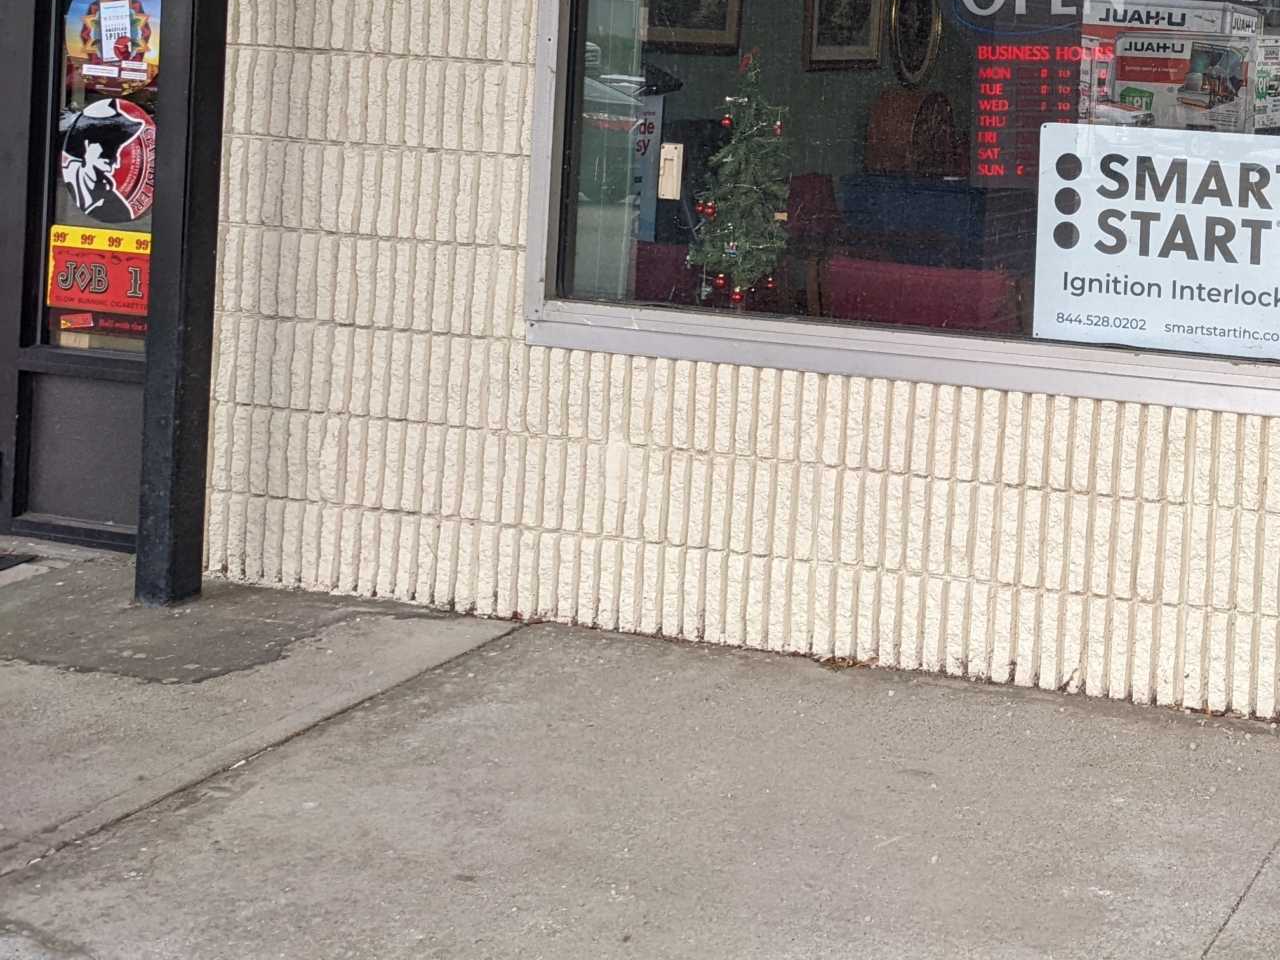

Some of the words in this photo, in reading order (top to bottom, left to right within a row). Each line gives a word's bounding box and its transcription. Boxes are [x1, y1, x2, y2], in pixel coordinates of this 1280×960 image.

[977, 45, 1049, 61] BUSINESS
[1055, 46, 1114, 62] HOURS
[978, 67, 1011, 80] MON
[1057, 70, 1071, 78] TO
[980, 84, 1004, 96] TUE
[1057, 86, 1071, 95] TO
[978, 100, 1009, 112] WED
[1057, 102, 1071, 111] TO
[978, 115, 1007, 128] THU
[978, 148, 1000, 160] SAT
[978, 164, 1005, 176] SUN
[57, 261, 109, 293] JOB
[1062, 271, 1163, 299] Ignition
[1056, 312, 1147, 331] 844.528.0202
